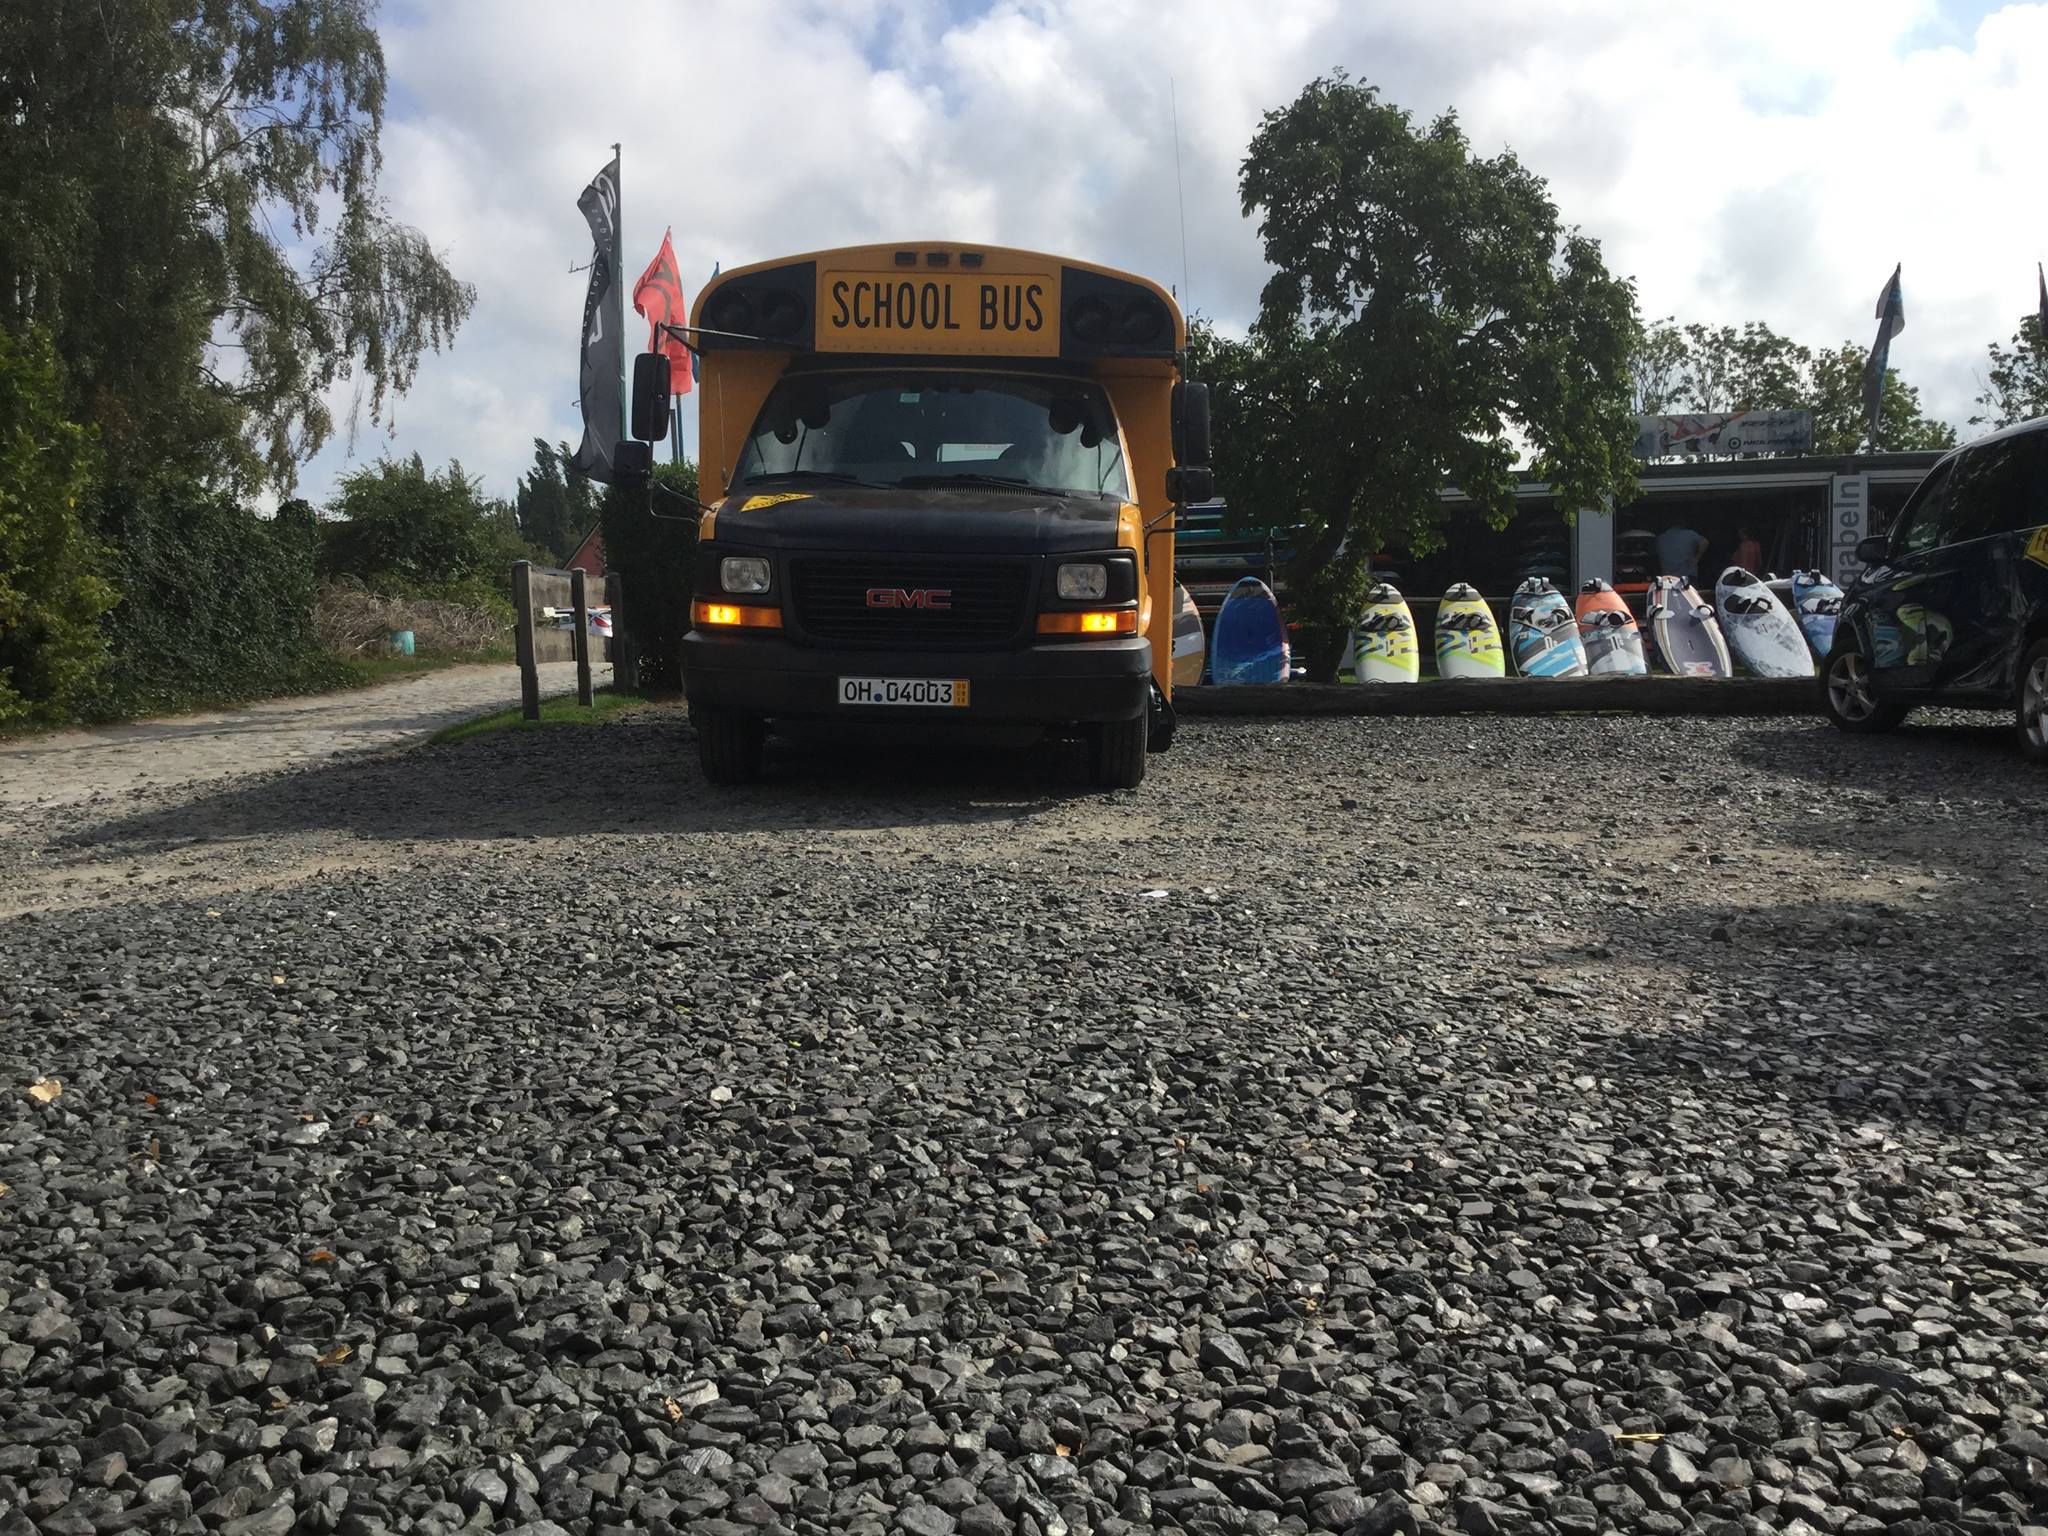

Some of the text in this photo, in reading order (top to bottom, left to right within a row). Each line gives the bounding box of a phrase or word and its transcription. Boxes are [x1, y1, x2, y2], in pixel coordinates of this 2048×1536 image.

[832, 280, 1043, 331] SCHOOL BUS
[866, 588, 951, 609] GMC
[844, 681, 872, 701] OH
[886, 682, 952, 703] 04003
